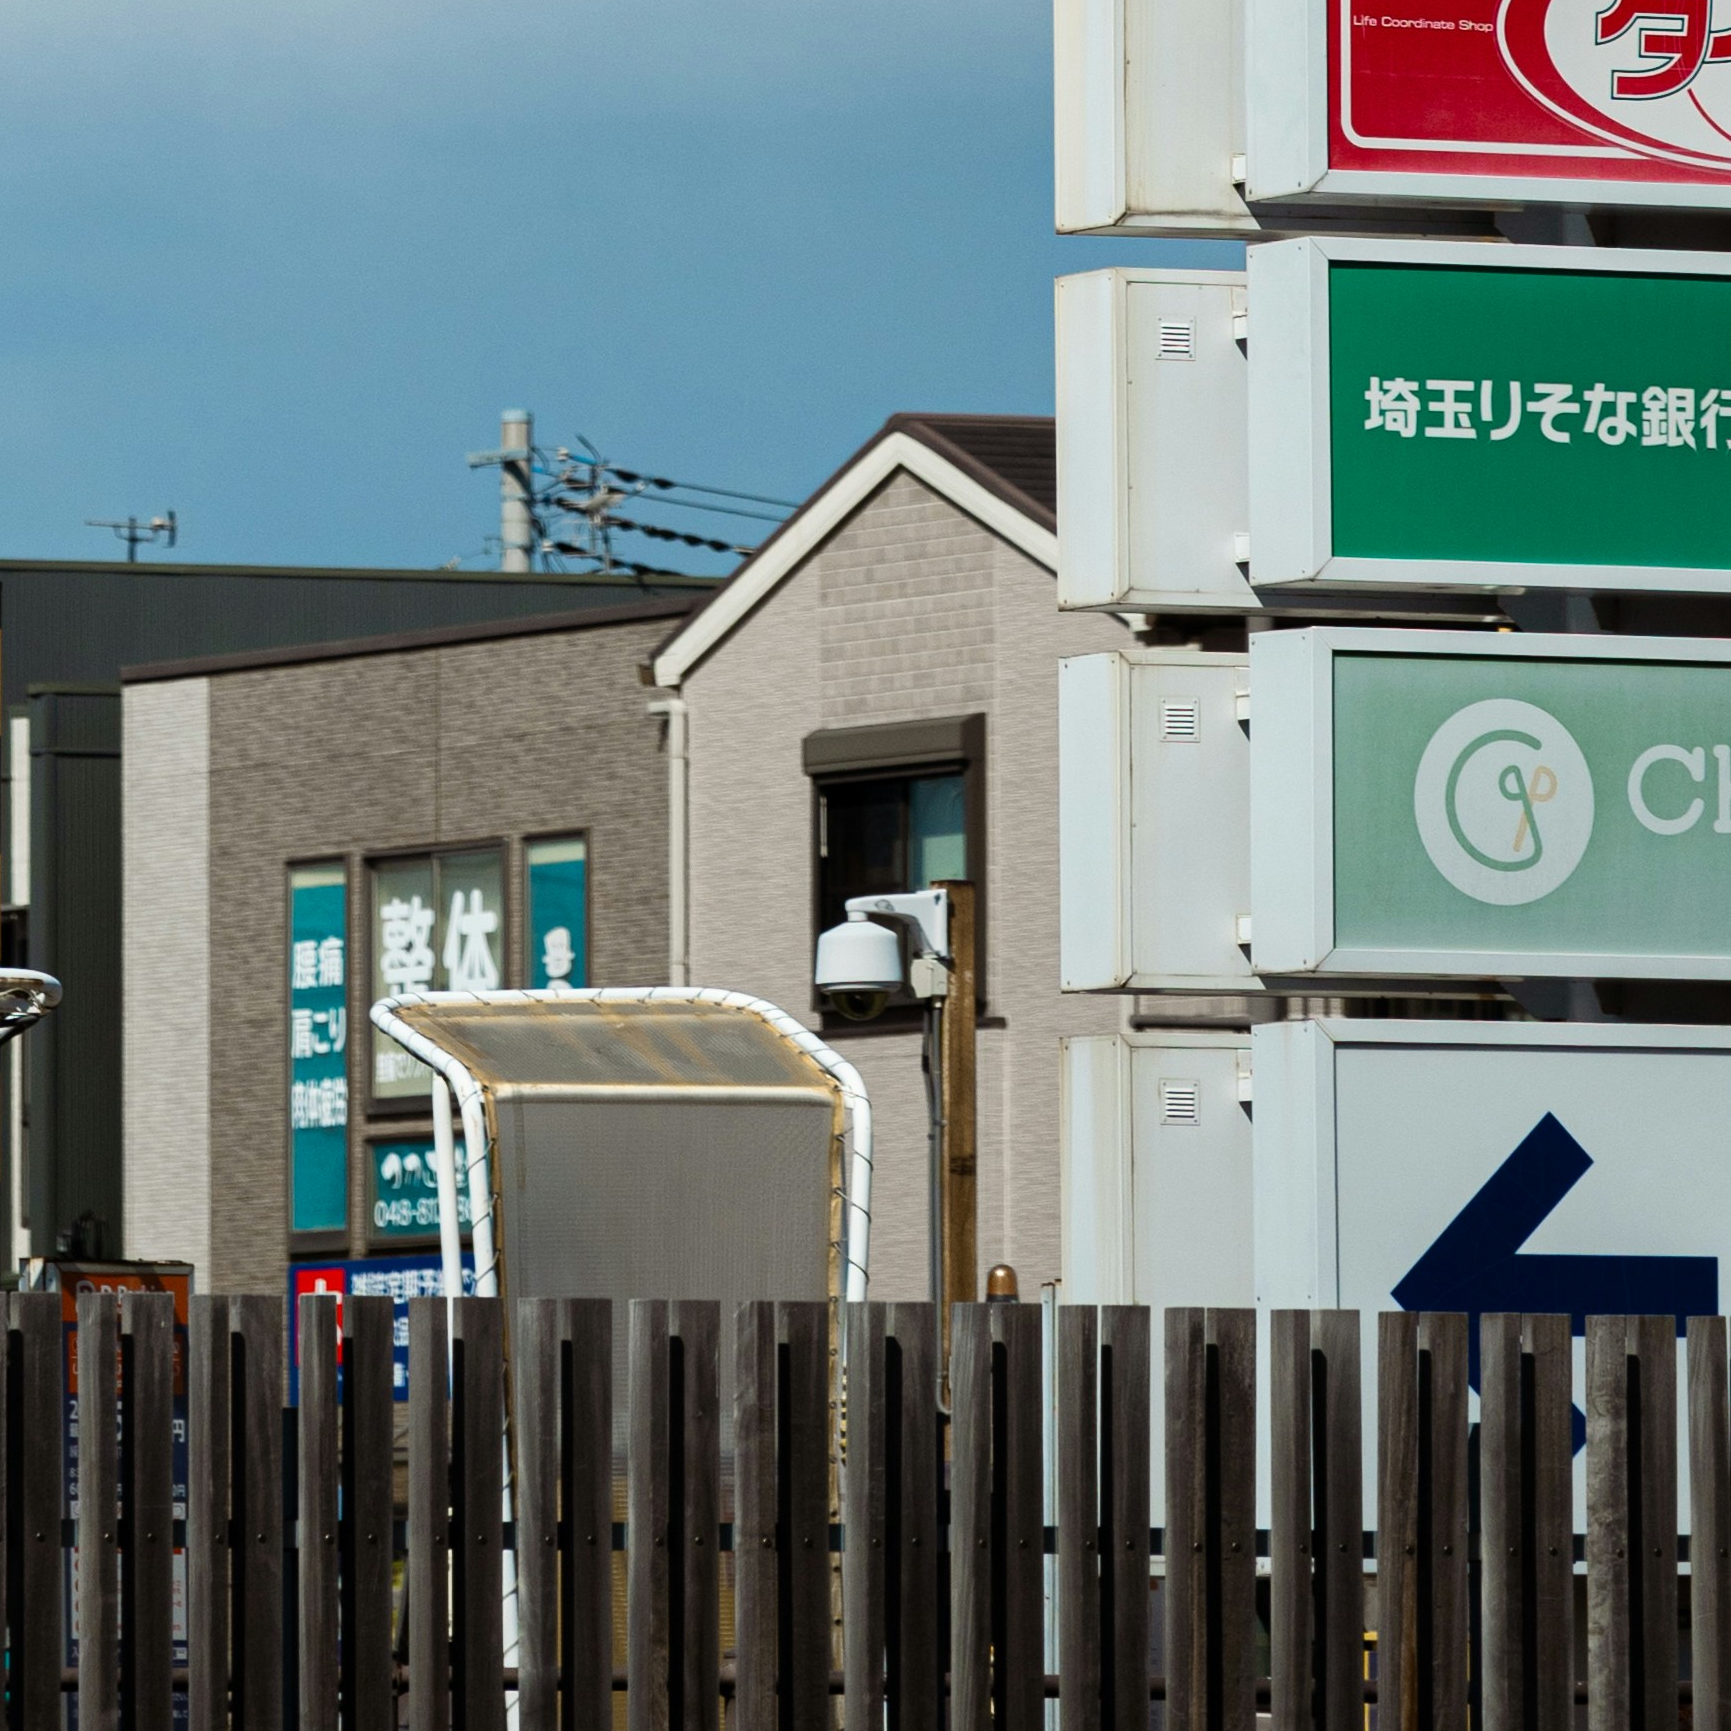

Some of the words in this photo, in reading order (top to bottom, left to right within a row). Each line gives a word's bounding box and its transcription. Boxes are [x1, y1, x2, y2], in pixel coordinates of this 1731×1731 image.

[1353, 15, 1377, 27] Life
[1381, 16, 1455, 30] Coordinate
[1458, 19, 1494, 33] Shop
[1364, 376, 1731, 453] 埼玉りそな銀行
[291, 936, 345, 991] 腰痛
[290, 1006, 347, 1059] 肩こり
